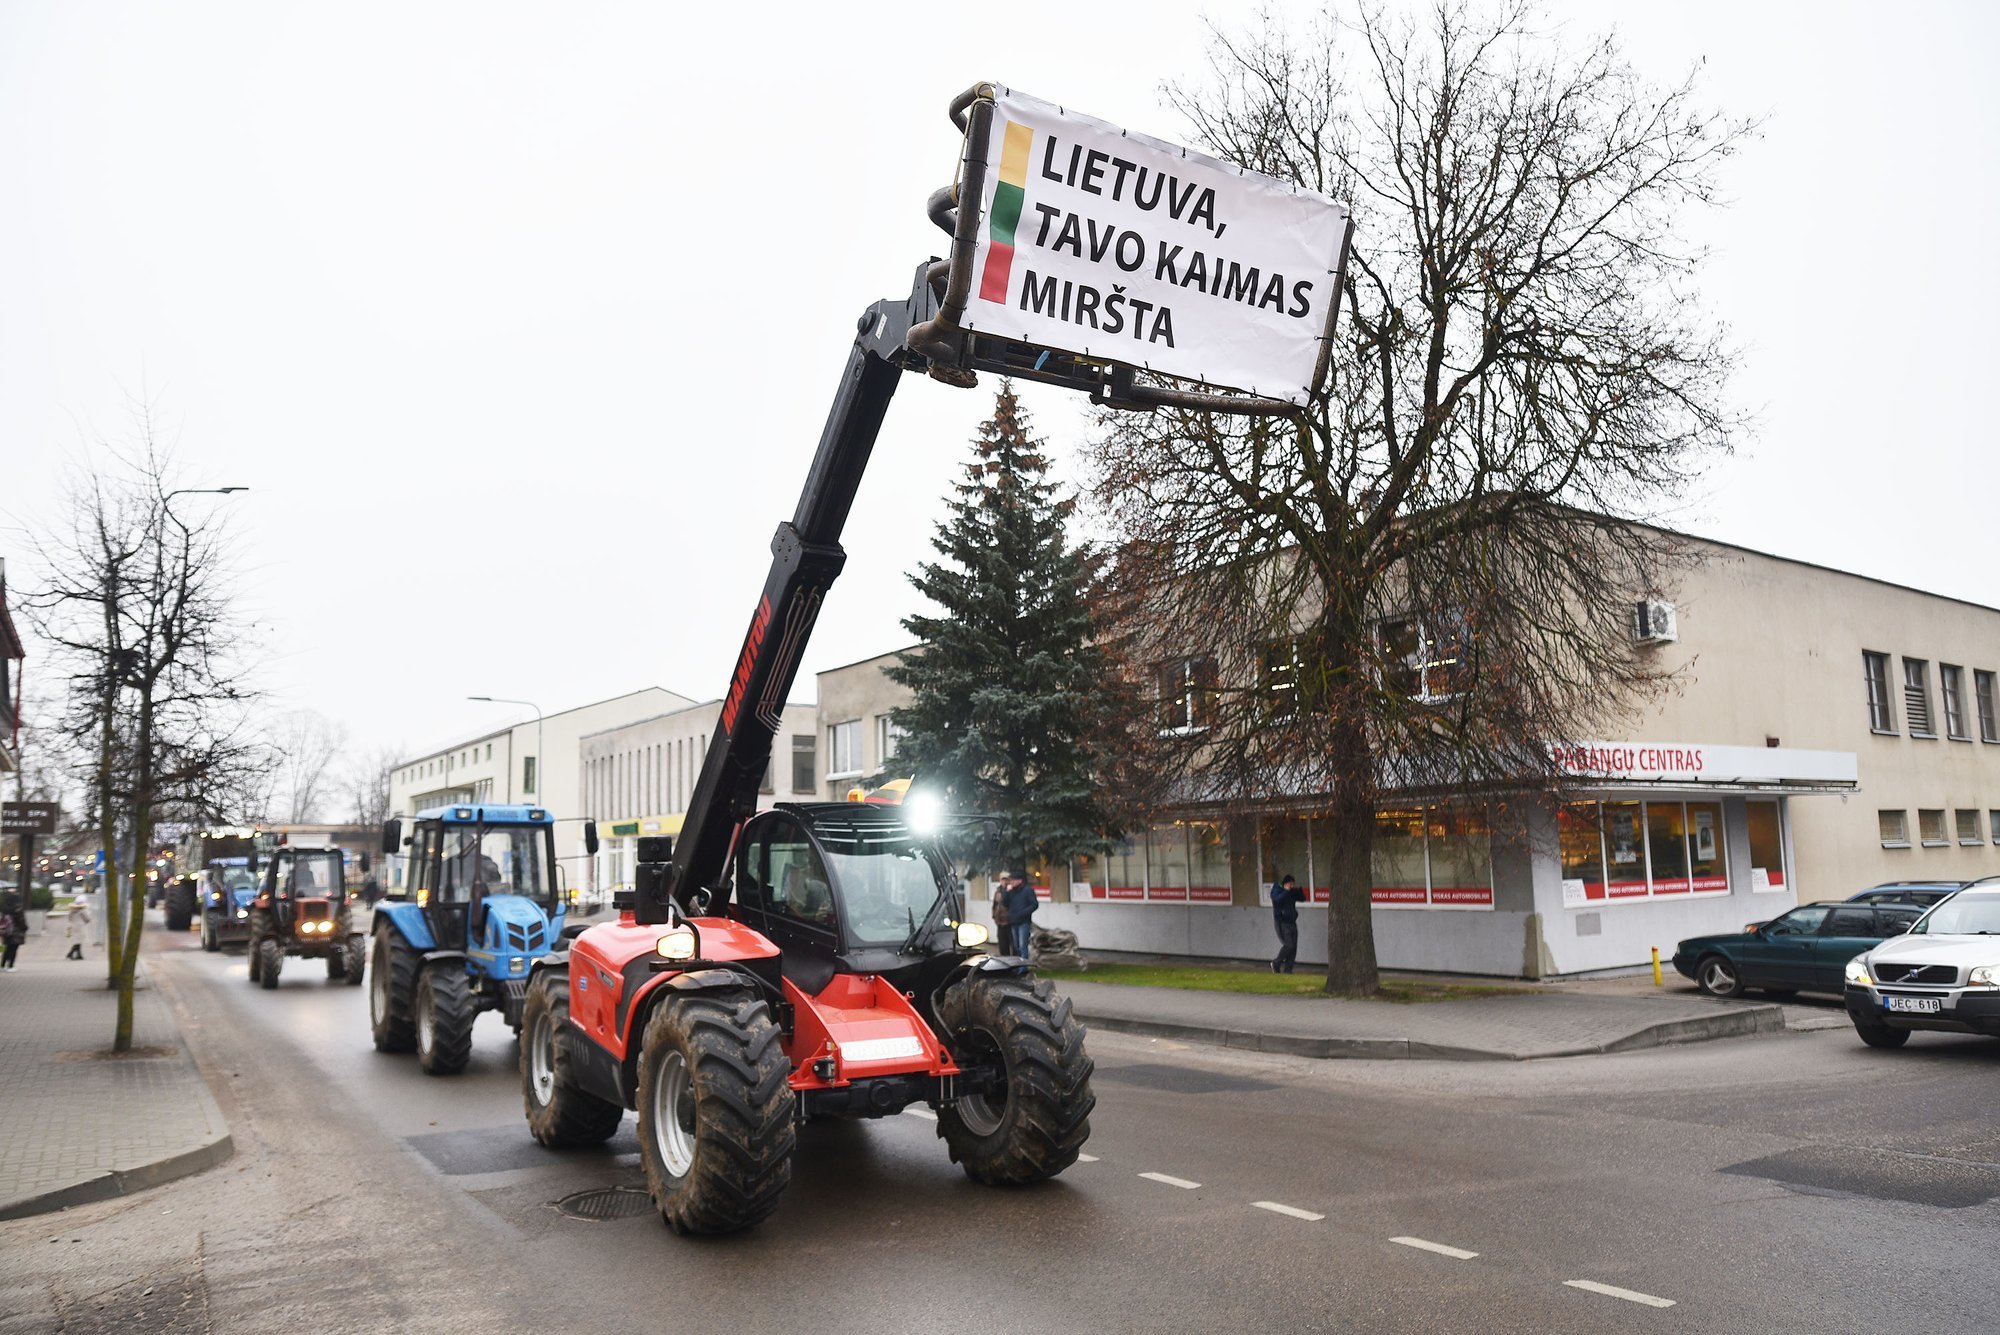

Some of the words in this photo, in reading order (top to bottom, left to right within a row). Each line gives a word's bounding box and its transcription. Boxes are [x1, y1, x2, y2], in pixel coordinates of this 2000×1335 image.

[1042, 135, 1227, 239] LIETUVA,
[1034, 202, 1146, 272] TAVO
[1155, 241, 1314, 319] KAIMAS
[1019, 270, 1175, 349] MIRŠTA
[722, 594, 771, 736] MANITOU
[1639, 749, 1702, 771] CENTRAS
[1891, 999, 1911, 1009] JEC
[1919, 1000, 1938, 1010] 618
